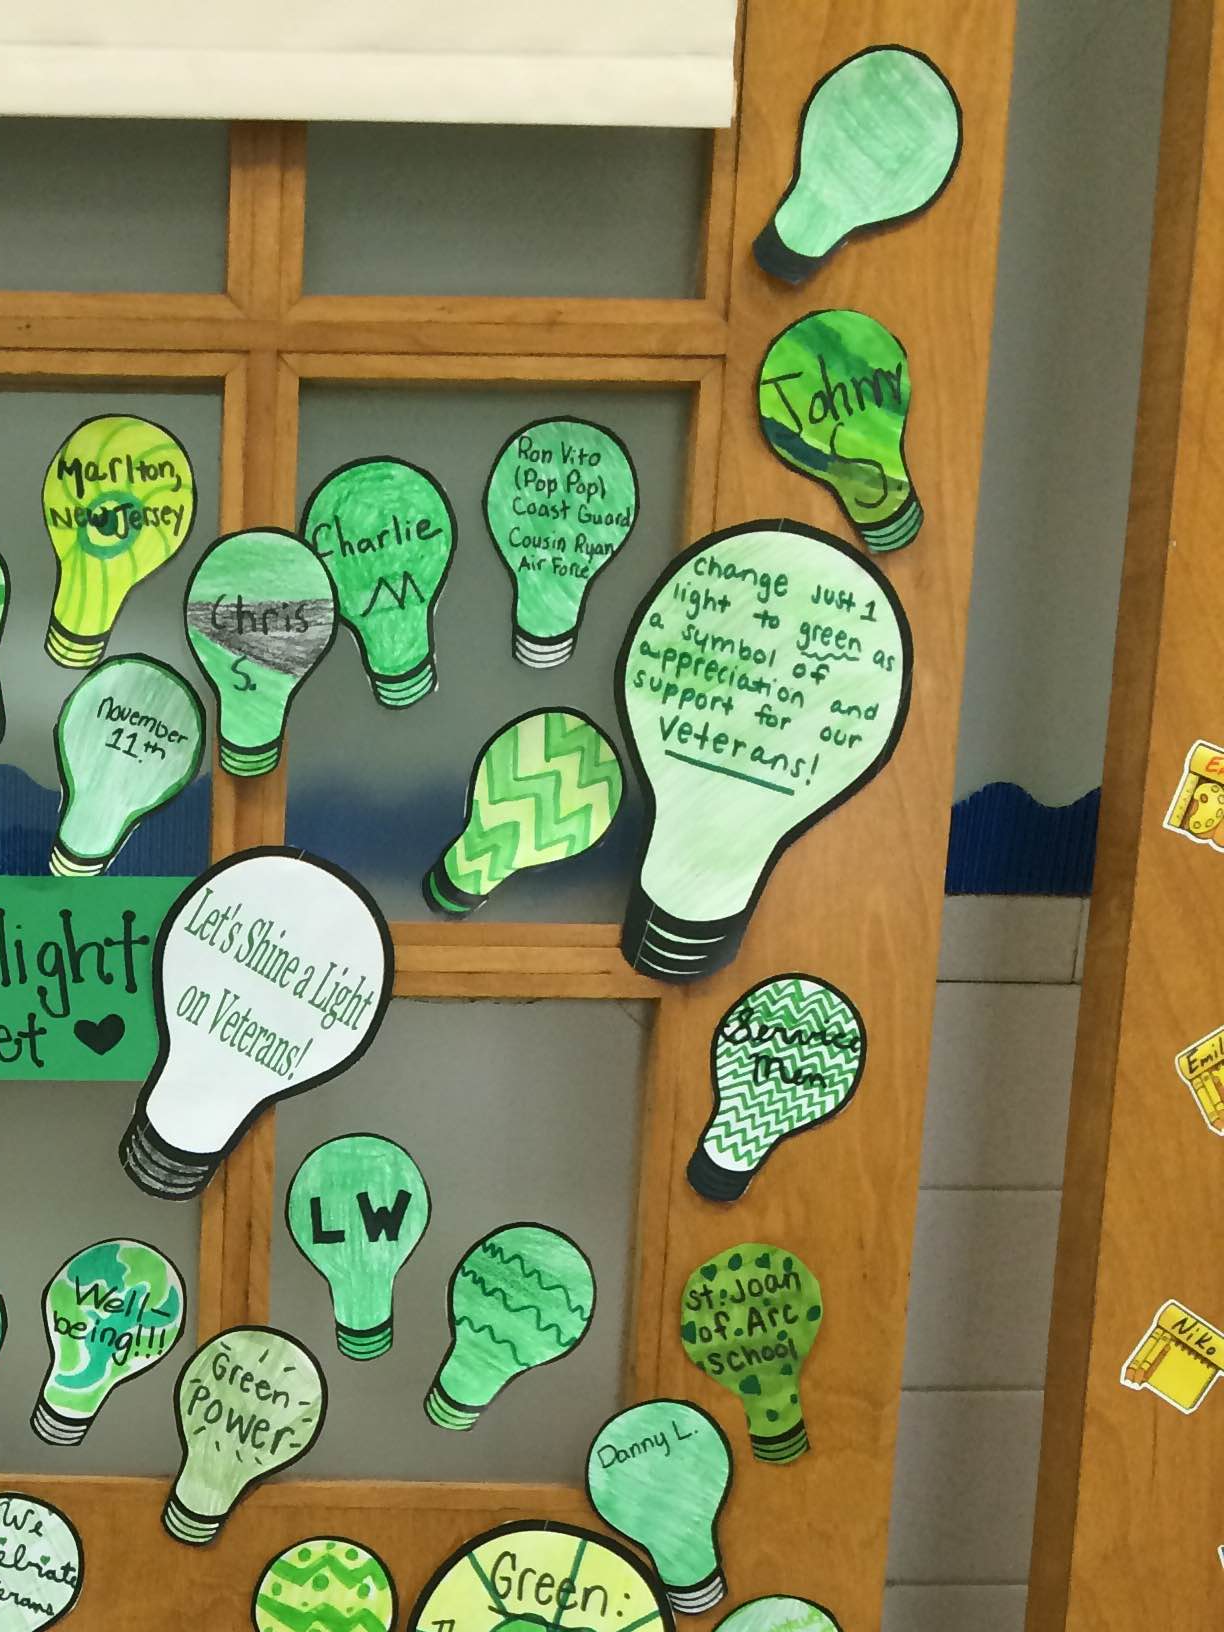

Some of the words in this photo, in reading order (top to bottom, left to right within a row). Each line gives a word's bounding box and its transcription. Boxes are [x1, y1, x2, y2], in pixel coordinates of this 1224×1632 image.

[517, 436, 553, 464] Ron
[560, 441, 601, 467] Vito
[58, 458, 183, 498] Marlton,
[514, 466, 558, 499] (Pop
[566, 469, 607, 503] Pop)
[512, 496, 571, 520] Coast
[577, 503, 631, 528] Guard
[311, 515, 444, 559] Charlie
[508, 526, 567, 552] Cousin
[574, 533, 616, 563] Ryan
[517, 555, 547, 573] Air
[551, 556, 590, 580] Force
[211, 593, 311, 636] Chris
[673, 582, 732, 620] light
[753, 609, 780, 630] to
[796, 621, 862, 653] green
[872, 648, 895, 672] as
[860, 600, 878, 623] 1
[650, 612, 664, 630] a
[681, 623, 777, 667] symbol
[792, 663, 831, 685] of
[231, 654, 257, 692] S.
[640, 640, 804, 708] appreciation
[830, 700, 879, 721] and
[633, 669, 735, 716] support
[754, 708, 792, 731] for
[819, 725, 863, 748] our
[184, 887, 243, 964] Let's
[233, 917, 301, 990] Shine
[294, 969, 315, 1002] a
[310, 961, 376, 1032] Light
[176, 983, 202, 1027] on
[208, 987, 315, 1082] Veterans!
[730, 1271, 802, 1304] Joan
[699, 1311, 730, 1343] of
[747, 1303, 799, 1337] Arc
[211, 1351, 291, 1409] Green
[596, 1432, 672, 1470] Danny
[672, 1420, 700, 1442] L.
[2, 1499, 44, 1538] We
[489, 1550, 633, 1619] Green:
